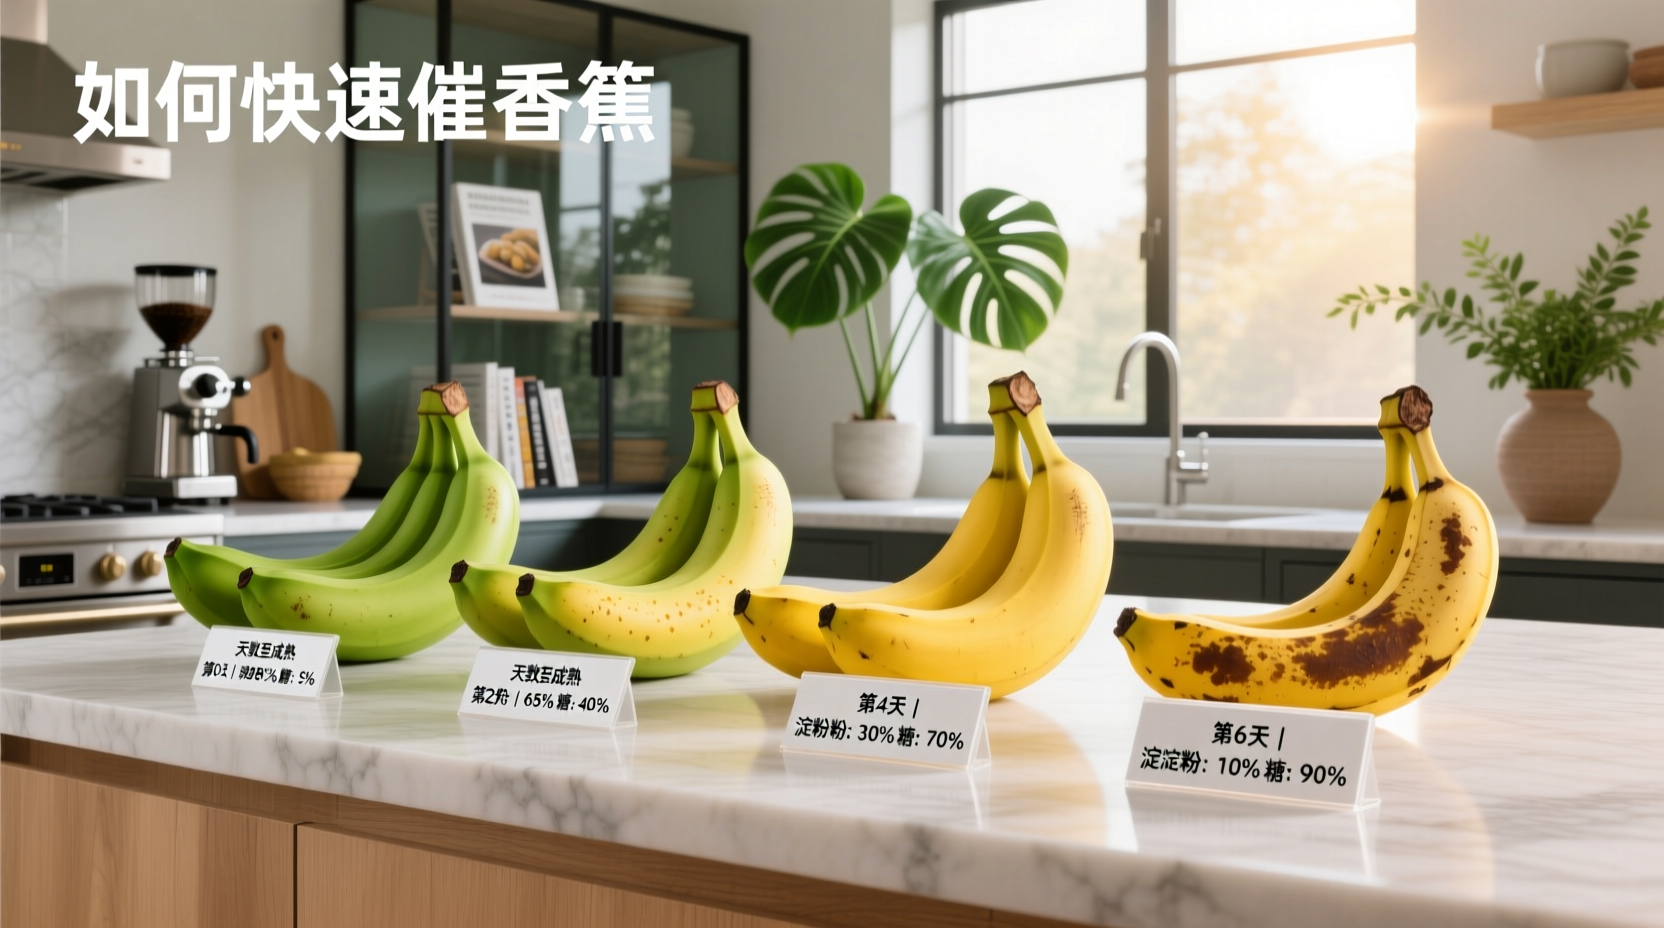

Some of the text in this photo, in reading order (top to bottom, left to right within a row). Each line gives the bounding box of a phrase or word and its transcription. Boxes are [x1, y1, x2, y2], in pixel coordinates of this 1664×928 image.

[856, 692, 907, 717] 第4天
[857, 724, 895, 745] 30%
[926, 729, 964, 751] 70%
[1211, 720, 1270, 749] 第6天
[1218, 756, 1261, 779] 10%
[1299, 763, 1348, 787] 90%
